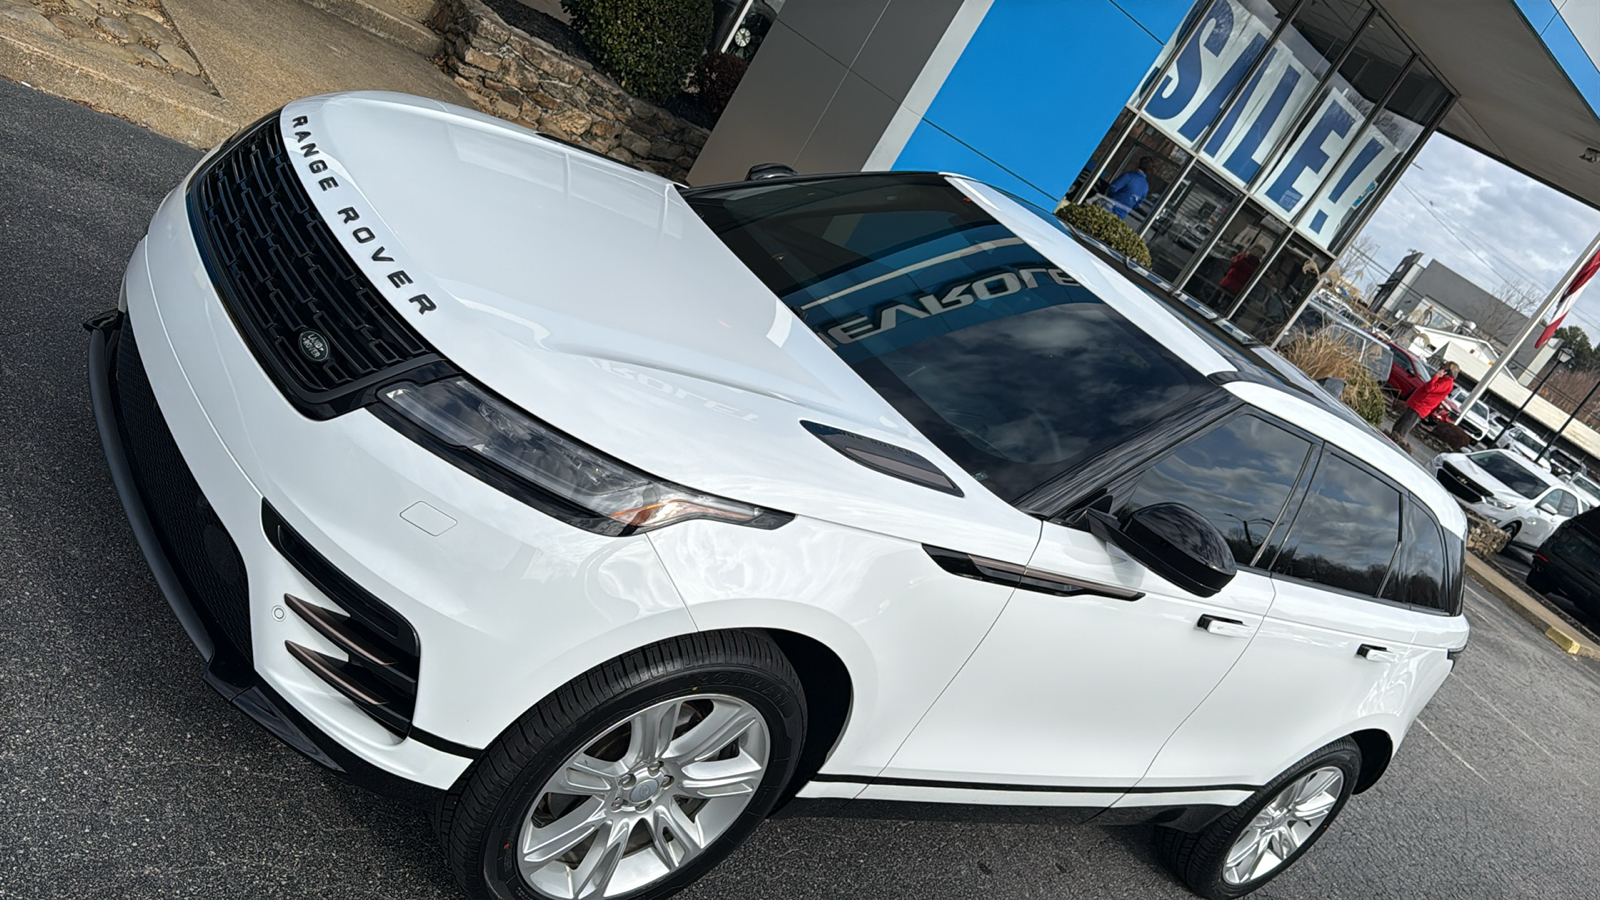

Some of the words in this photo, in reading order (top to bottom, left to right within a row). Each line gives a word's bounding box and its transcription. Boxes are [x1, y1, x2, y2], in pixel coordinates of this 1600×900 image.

[1139, 0, 1385, 235] SALE!
[292, 115, 339, 191] RANGE
[337, 206, 437, 315] ROVER
[302, 339, 321, 358] ROVER
[307, 333, 323, 349] LAND
